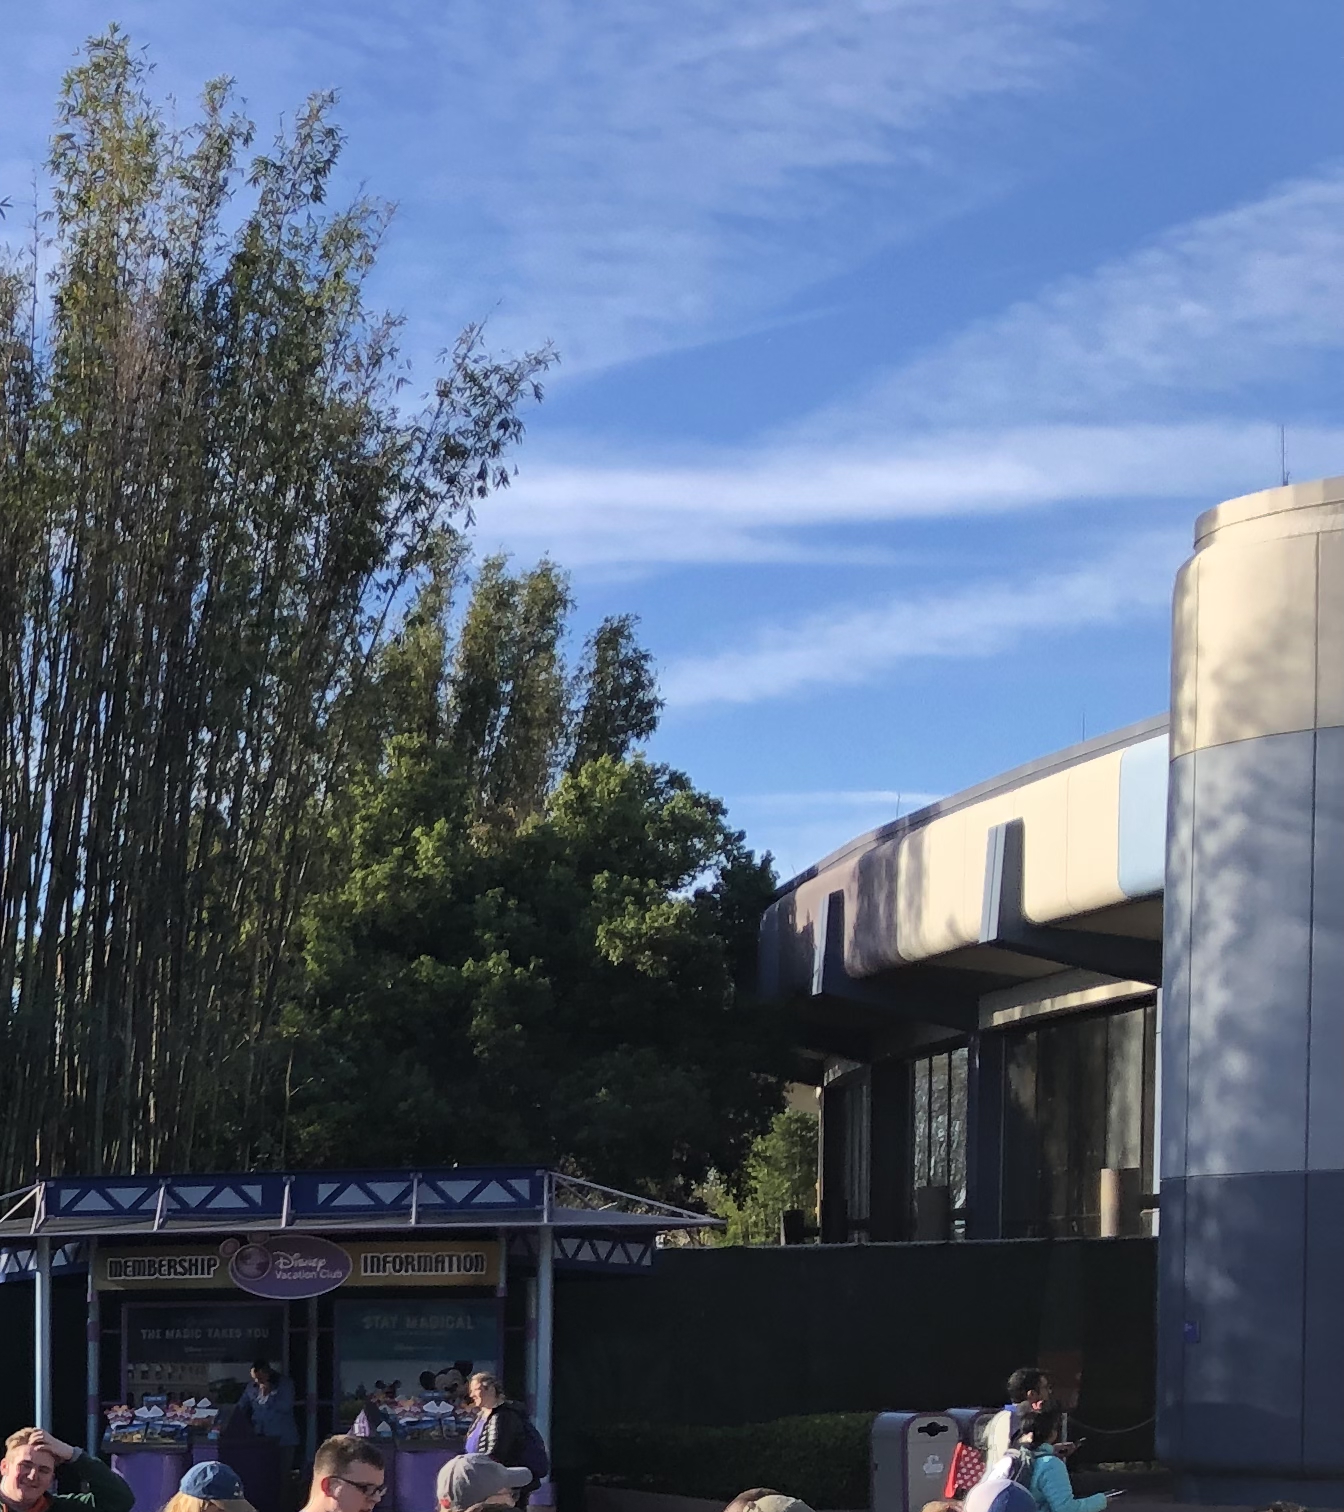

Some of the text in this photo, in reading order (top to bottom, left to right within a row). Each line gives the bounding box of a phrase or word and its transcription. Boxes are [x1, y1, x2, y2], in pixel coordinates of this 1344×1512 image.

[107, 1256, 220, 1280] MEMBERSHIP
[273, 1251, 327, 1271] Disney
[361, 1253, 486, 1276] INFORMATION
[275, 1268, 343, 1280] Vacation Club
